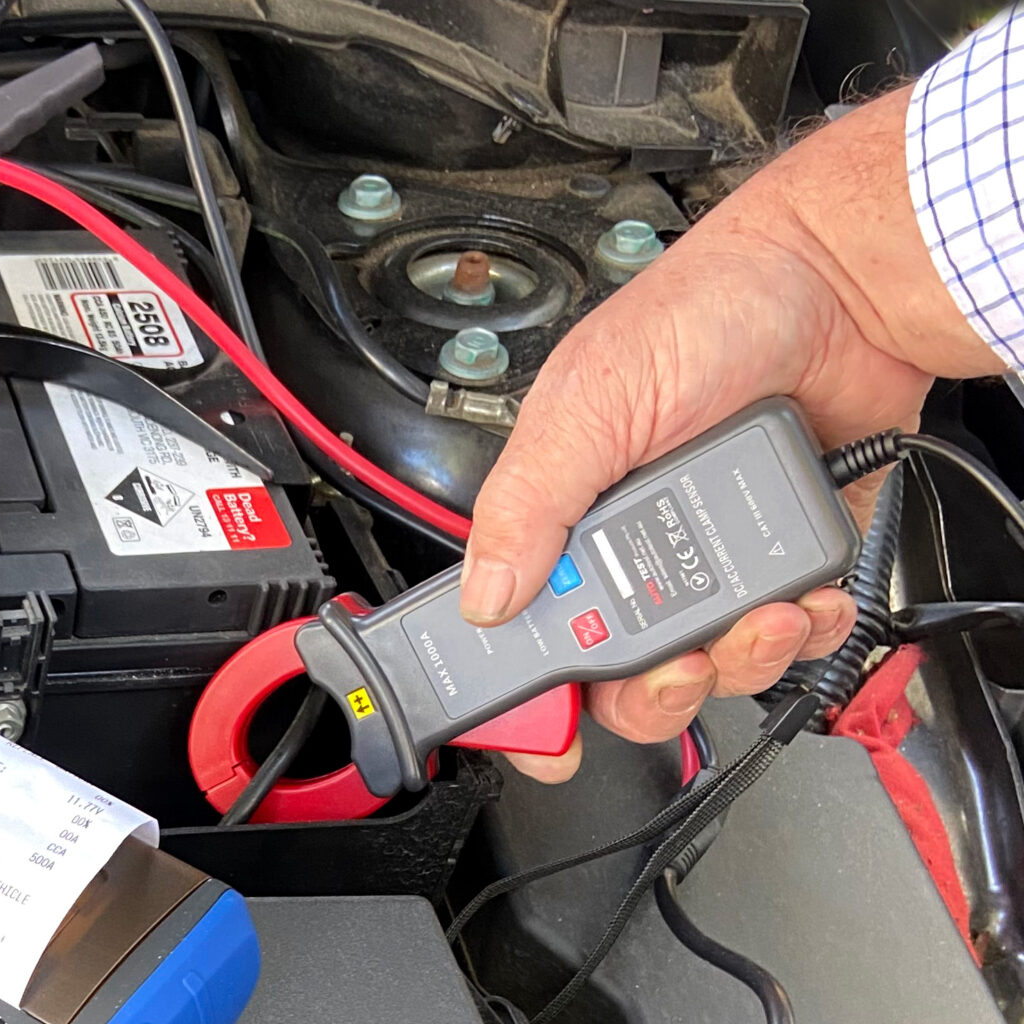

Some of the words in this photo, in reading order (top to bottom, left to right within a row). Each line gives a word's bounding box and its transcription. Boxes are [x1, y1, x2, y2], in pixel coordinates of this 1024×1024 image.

[126, 301, 169, 347] 2508
[679, 473, 704, 510] SENSOR
[732, 467, 748, 491] MAX
[211, 493, 227, 515] CALL
[222, 493, 257, 542] Battery?
[237, 492, 263, 523] Dead
[656, 497, 676, 530] RoHS
[188, 505, 212, 539] UN2794
[695, 506, 718, 536] CLAMP
[757, 520, 772, 538] CAT
[709, 533, 736, 574] CURRENT
[727, 573, 748, 599] DC/AC
[633, 606, 649, 630] SERIAL
[419, 630, 444, 668] 1000A
[535, 637, 549, 657] LOW
[437, 668, 459, 697] MAX
[67, 794, 105, 816] 11.77V
[28, 852, 56, 871] 500A
[46, 842, 67, 857] CCA
